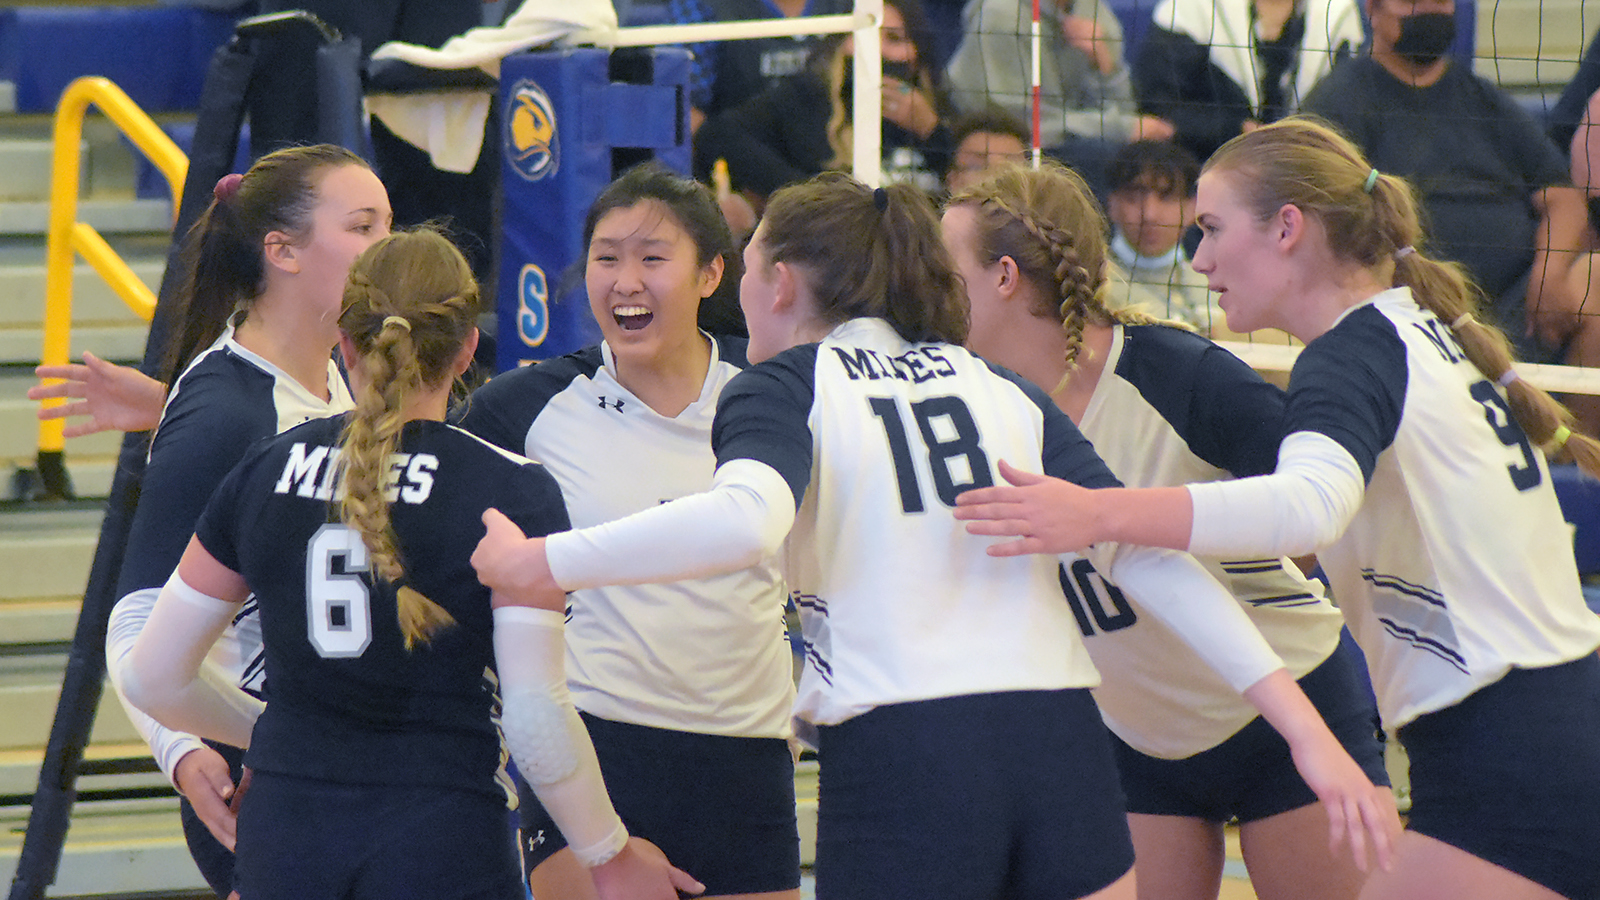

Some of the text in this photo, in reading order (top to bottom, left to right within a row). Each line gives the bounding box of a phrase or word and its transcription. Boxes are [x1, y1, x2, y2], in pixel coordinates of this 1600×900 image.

[274, 442, 439, 504] MIES
[866, 393, 996, 515] 18
[1468, 379, 1542, 492] 9
[305, 522, 373, 658] 6
[1058, 558, 1137, 636] 10
